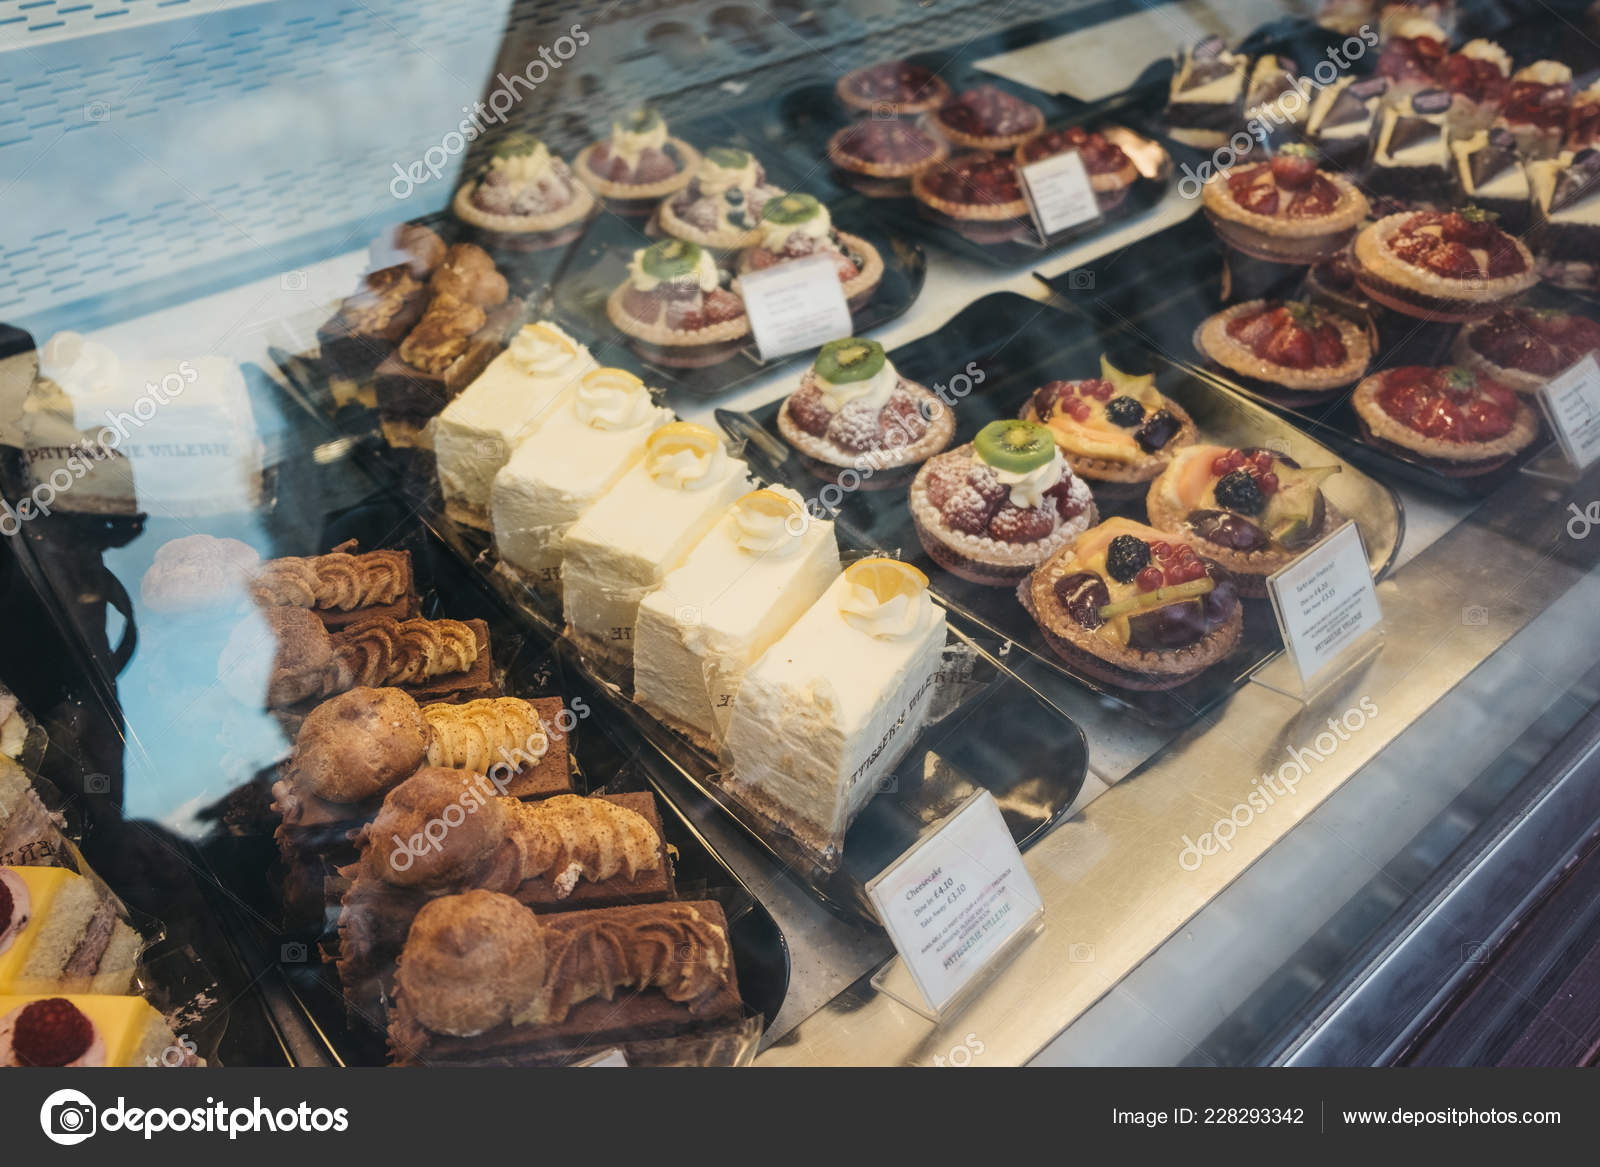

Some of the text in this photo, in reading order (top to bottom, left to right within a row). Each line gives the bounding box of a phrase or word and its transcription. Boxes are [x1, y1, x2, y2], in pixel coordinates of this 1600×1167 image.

[28, 443, 145, 463] PATIIE
[905, 865, 942, 901] Cheesecake
[933, 877, 954, 899] £4.10
[946, 884, 967, 905] £3.10
